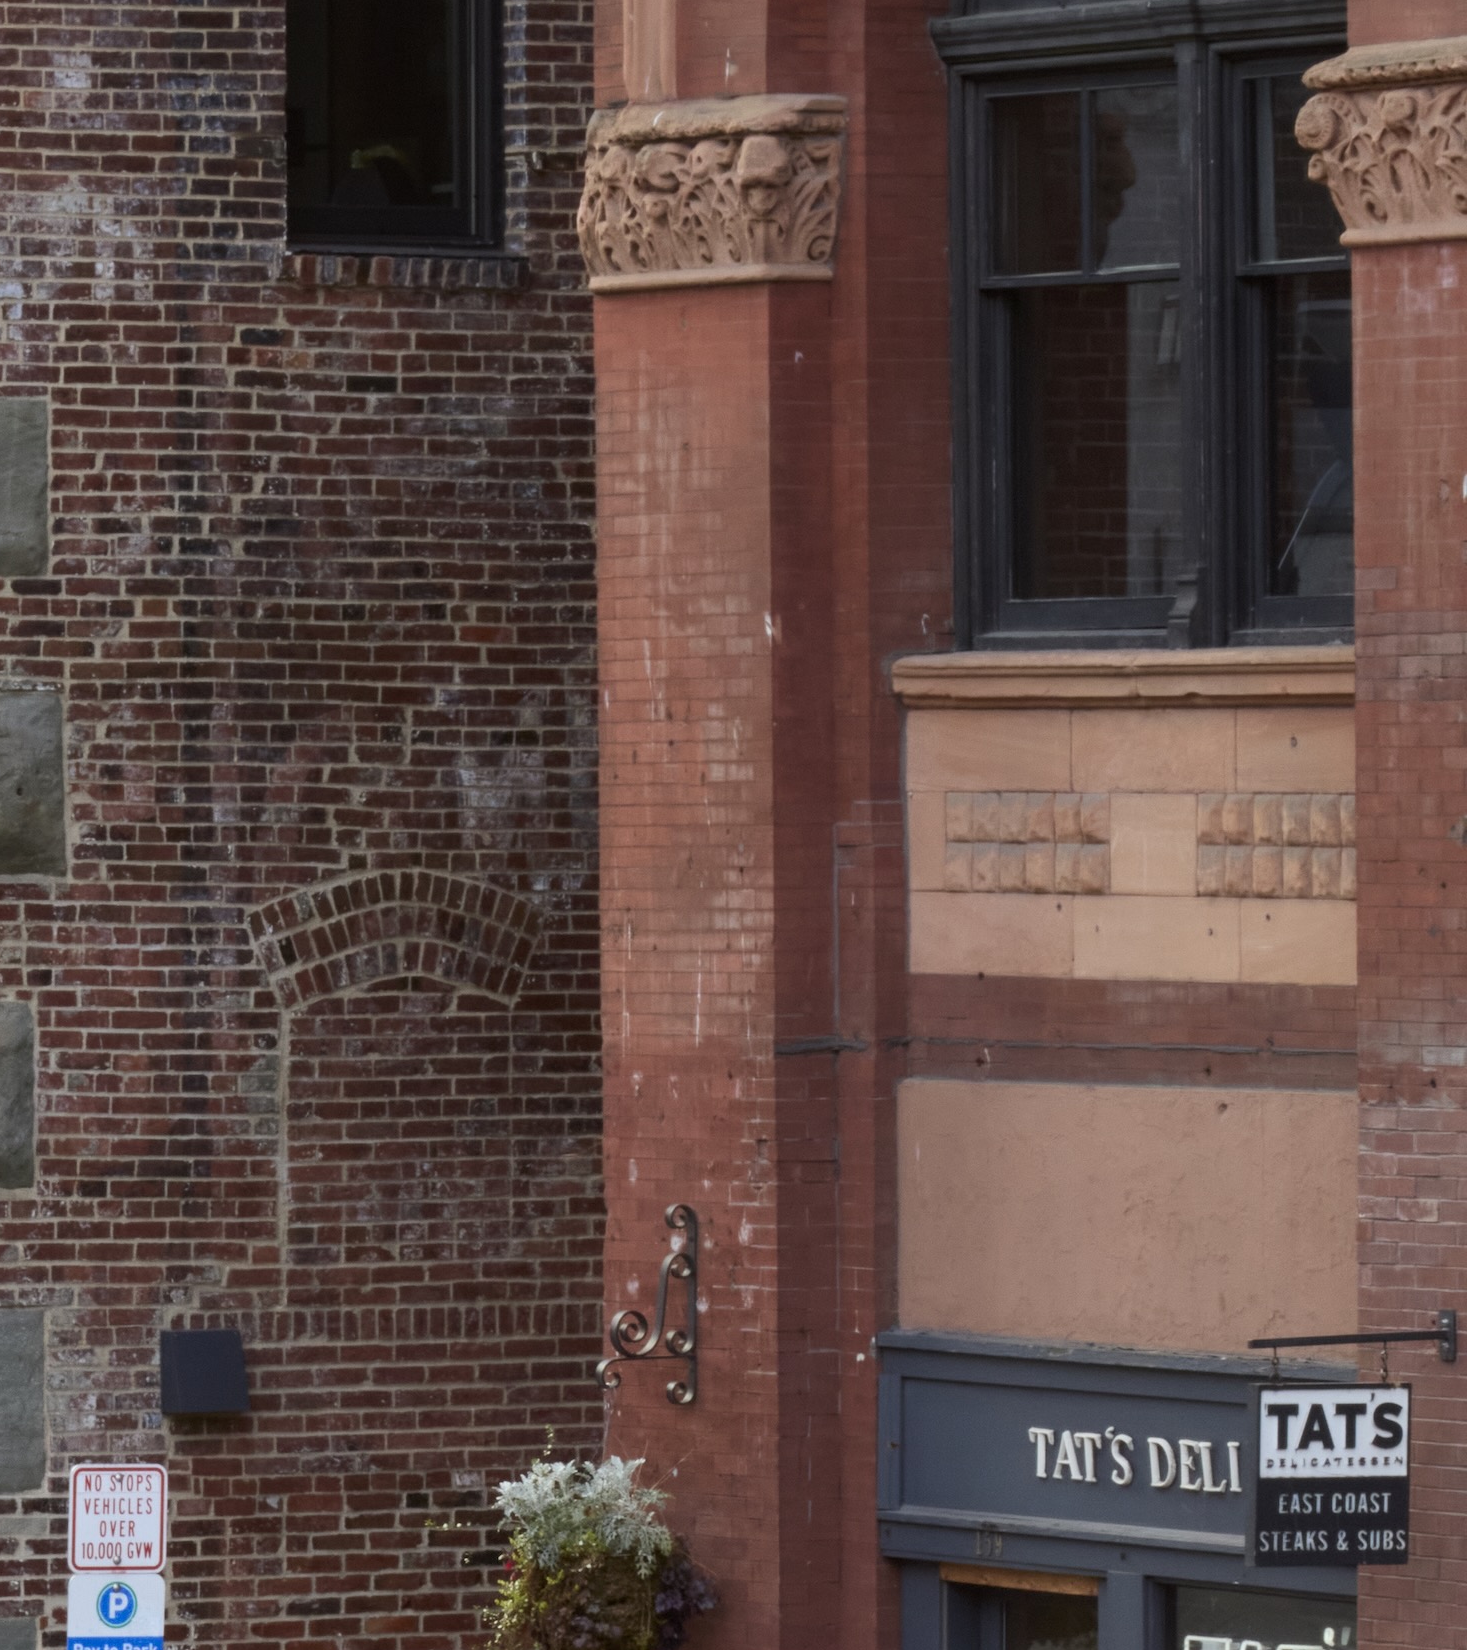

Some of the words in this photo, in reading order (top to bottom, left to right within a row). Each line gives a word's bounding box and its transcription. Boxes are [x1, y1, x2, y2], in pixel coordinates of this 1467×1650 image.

[1265, 1392, 1404, 1451] TAT'S
[1028, 1426, 1134, 1487] TAT'S
[1147, 1436, 1243, 1494] DELI
[1266, 1456, 1404, 1470] DELICATESSEN
[85, 1474, 102, 1492] NO
[110, 1474, 152, 1492] STOPS
[84, 1497, 153, 1515] VEHICLES
[1278, 1493, 1324, 1514] EAST
[1331, 1492, 1392, 1514] COAST
[99, 1520, 136, 1537] OVER
[1259, 1530, 1328, 1552] STEAKS
[1336, 1530, 1349, 1551] &
[1357, 1529, 1406, 1551] SUBS
[127, 1542, 153, 1559] GVW
